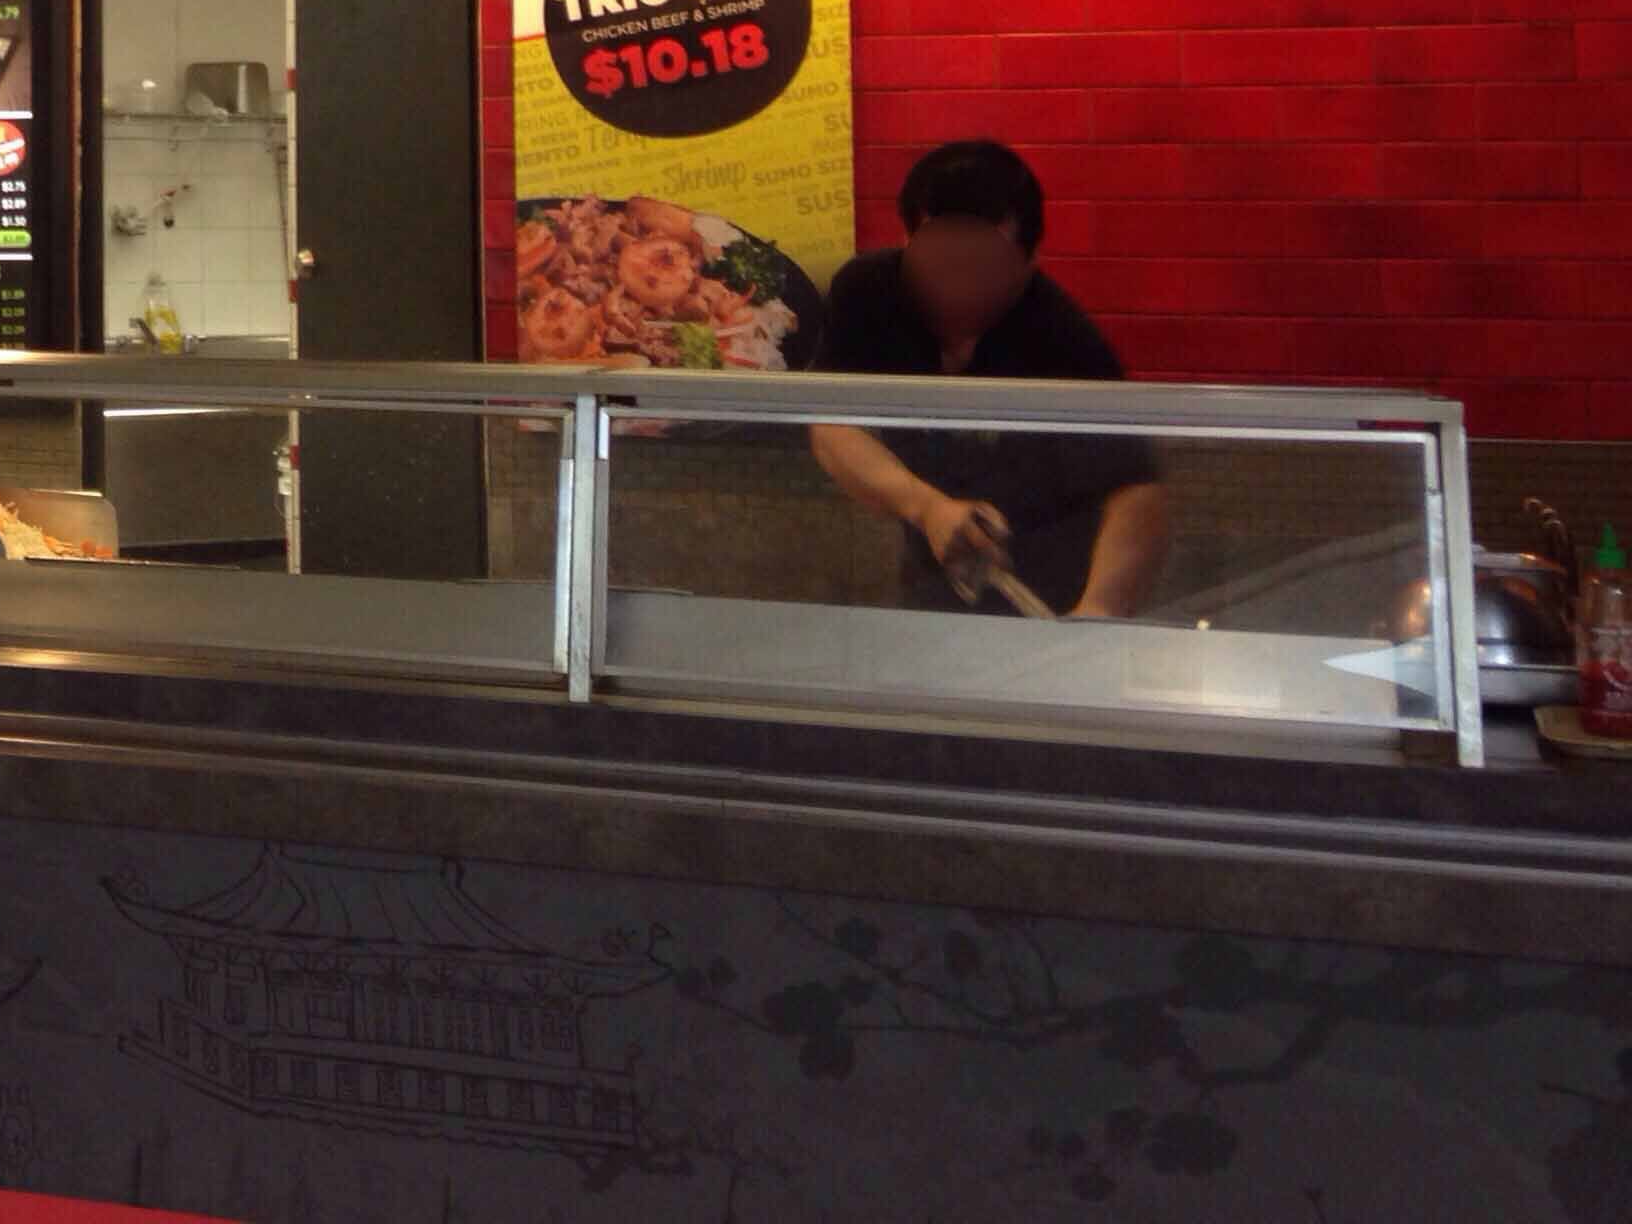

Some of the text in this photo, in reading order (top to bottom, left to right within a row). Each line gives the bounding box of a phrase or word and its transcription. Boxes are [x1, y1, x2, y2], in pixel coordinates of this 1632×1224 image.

[582, 19, 649, 43] CHICKEN
[651, 11, 689, 31] BEEF
[693, 9, 705, 22] &
[583, 22, 770, 98] $10.18
